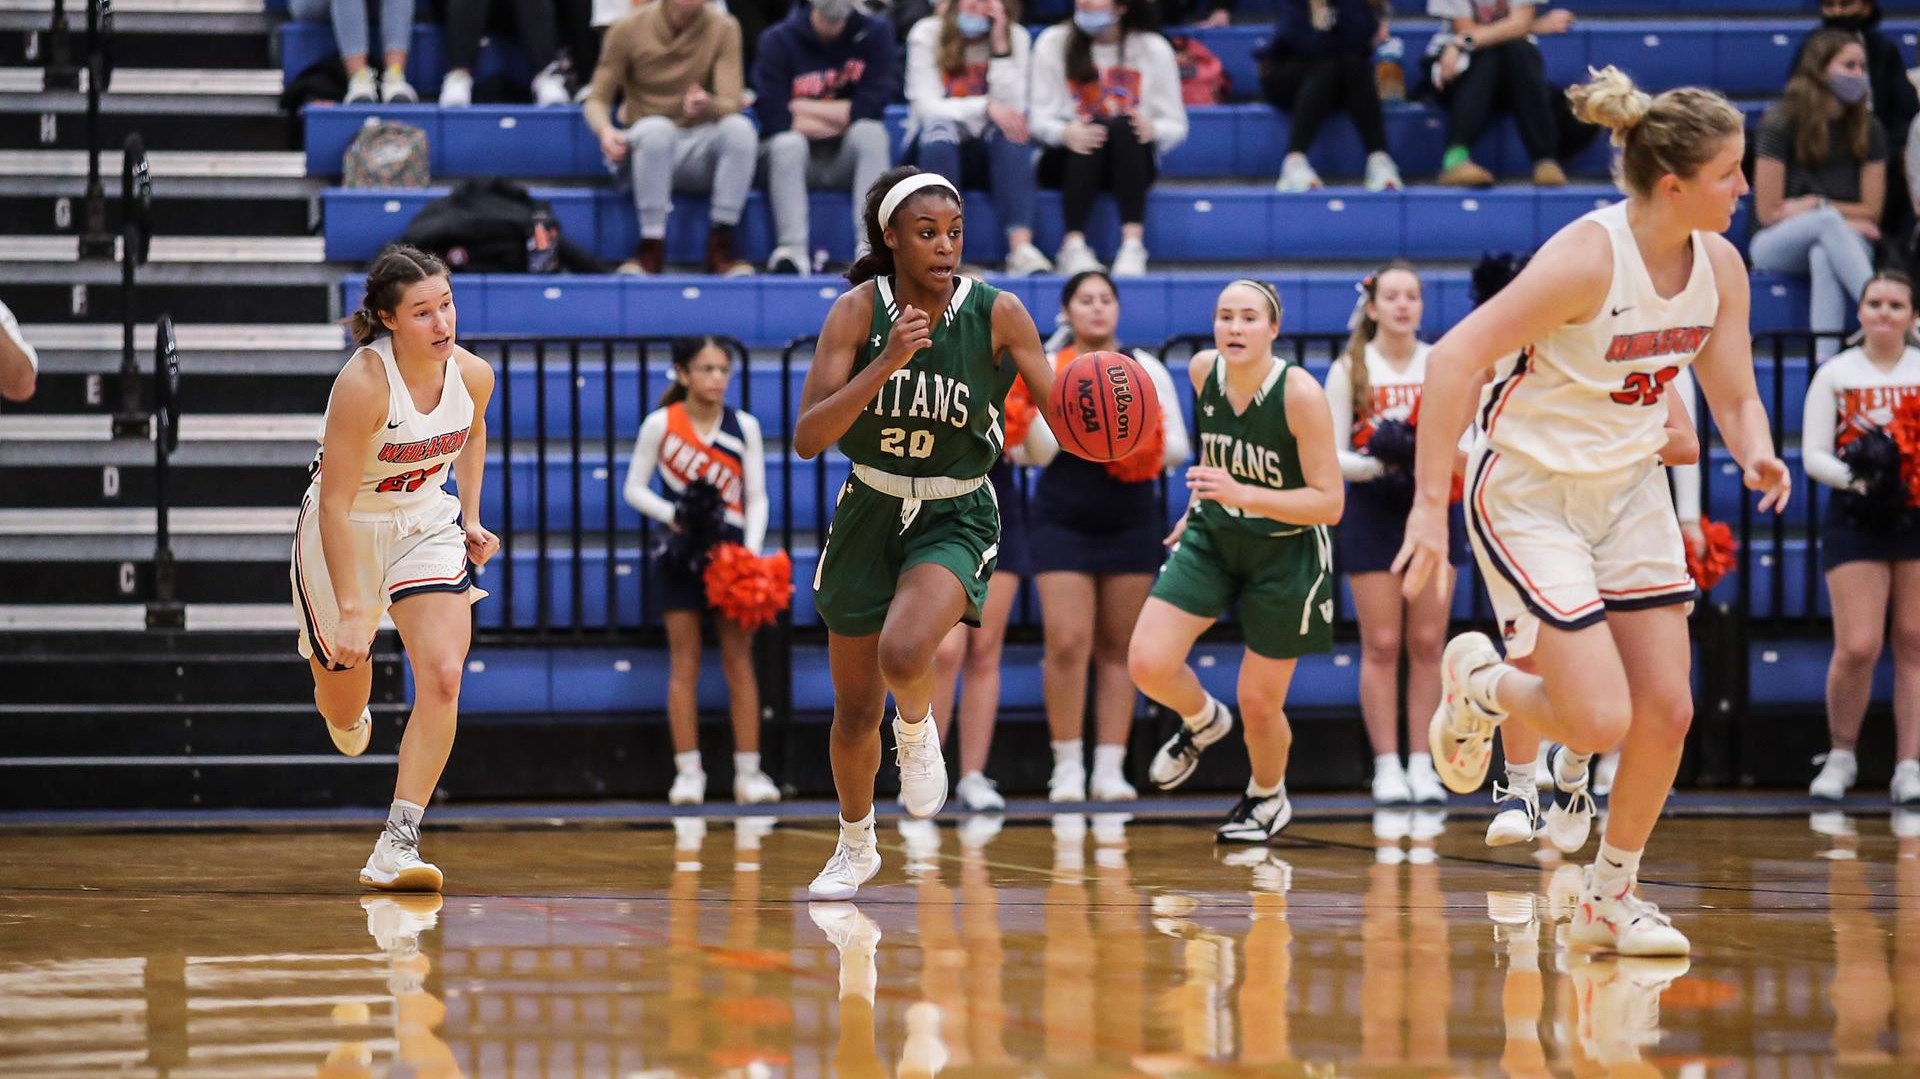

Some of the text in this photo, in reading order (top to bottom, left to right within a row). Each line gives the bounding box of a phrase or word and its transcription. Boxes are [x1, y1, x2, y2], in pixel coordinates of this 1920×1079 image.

[25, 30, 39, 60] J
[40, 113, 57, 143] H
[87, 374, 101, 405] E
[864, 368, 970, 428] ITANS
[1078, 378, 1100, 433] NCAA
[1106, 364, 1133, 441] Wilson
[880, 427, 935, 459] 20
[103, 465, 119, 497] D
[120, 562, 135, 593] C
